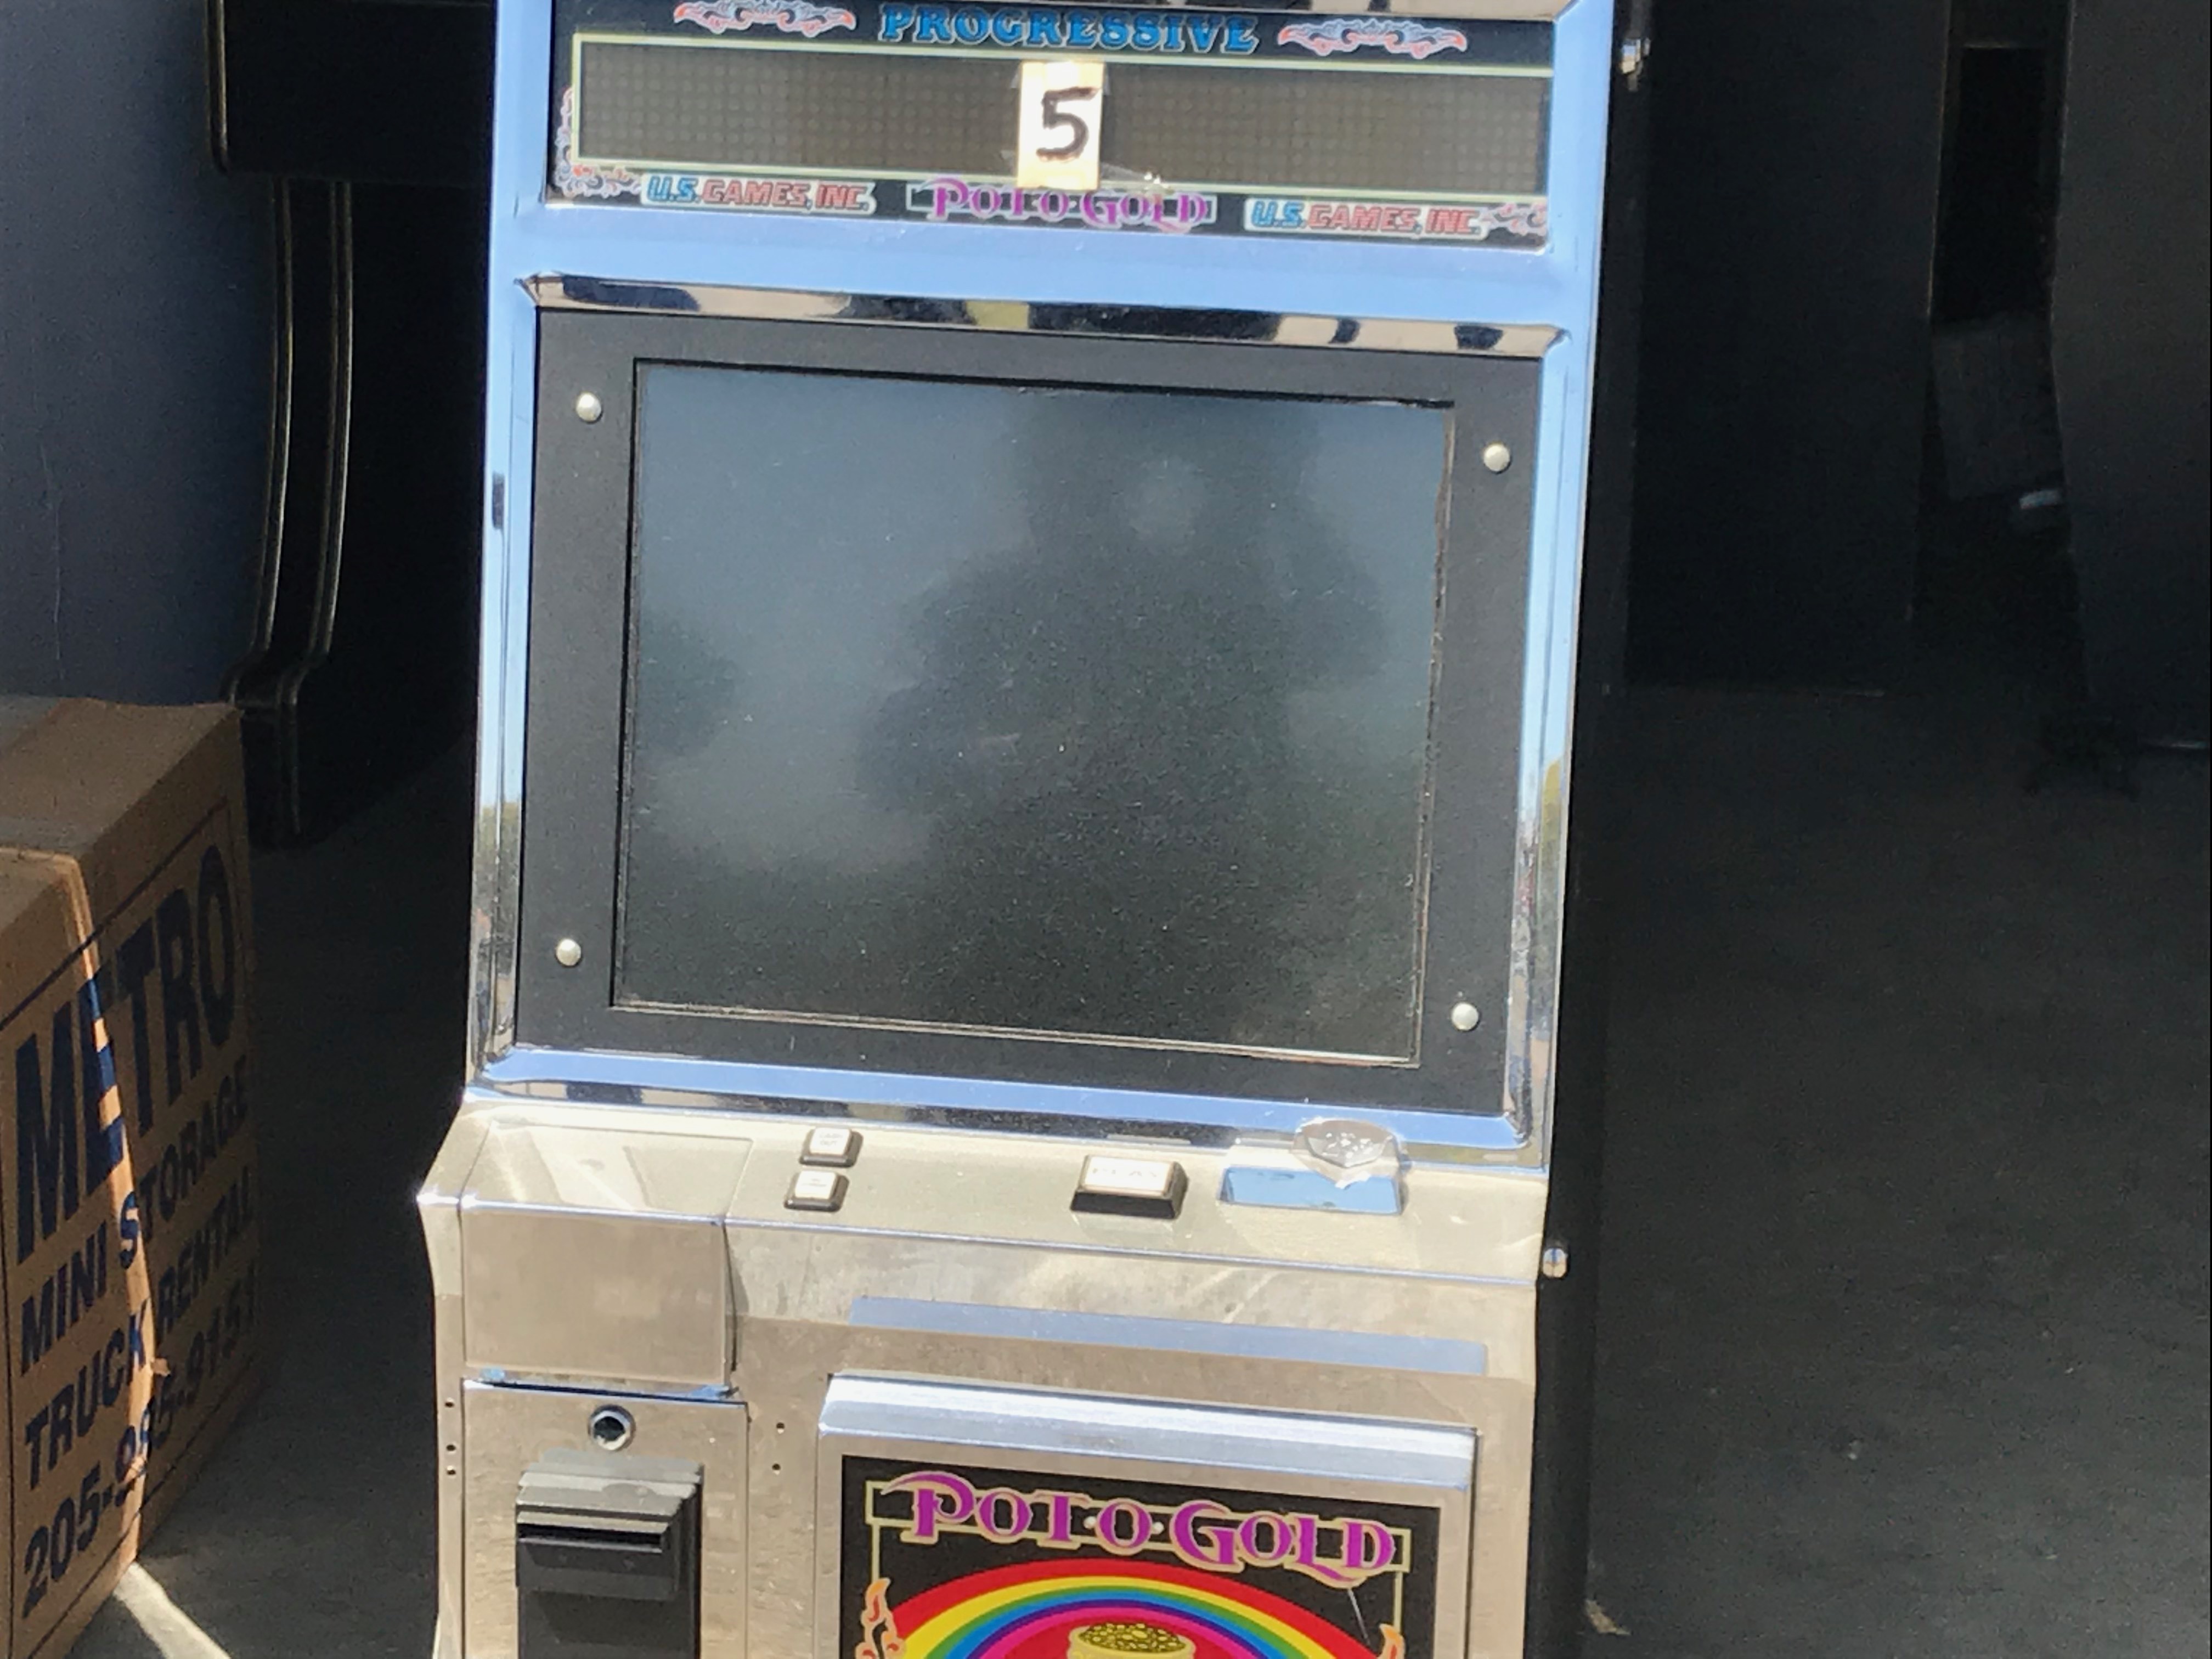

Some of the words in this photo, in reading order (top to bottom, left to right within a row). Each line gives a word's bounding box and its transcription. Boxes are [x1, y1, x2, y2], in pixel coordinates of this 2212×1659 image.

[878, 4, 1261, 55] PROGRESSIVE
[1036, 85, 1099, 162] 5
[647, 176, 702, 203] U.S.
[815, 182, 871, 212] INC.
[1079, 189, 1207, 233] GOLD
[1251, 200, 1306, 229] U.S.
[1425, 208, 1481, 235] INC.
[15, 845, 236, 1264] METRO
[21, 1221, 107, 1377] MINI
[120, 1053, 247, 1269] STORAGE
[25, 1296, 149, 1491] TRUCK
[157, 1165, 252, 1348] RENTAL
[1169, 1499, 1397, 1589] GOLD
